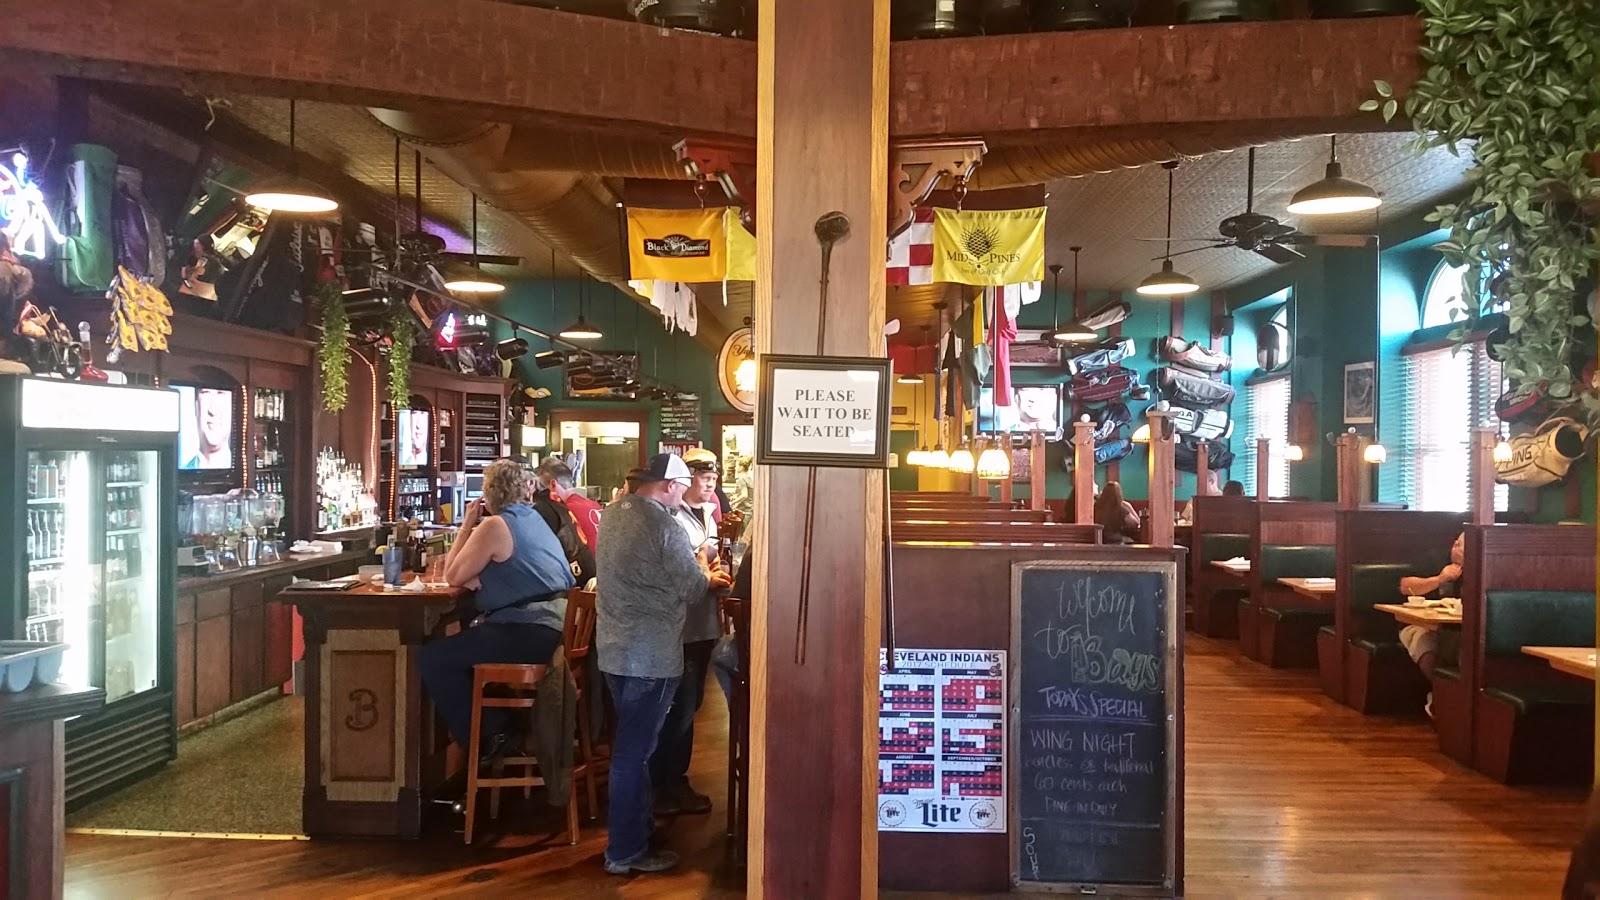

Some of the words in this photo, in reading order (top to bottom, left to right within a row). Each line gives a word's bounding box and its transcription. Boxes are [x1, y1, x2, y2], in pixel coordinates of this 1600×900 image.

[646, 241, 669, 252] Black
[681, 242, 709, 252] Diamond
[946, 250, 969, 263] MID
[989, 253, 1021, 264] PINES
[795, 389, 856, 402] PLEASE
[777, 406, 822, 419] WAIT
[825, 407, 847, 420] TO
[852, 408, 872, 420] BE
[1506, 445, 1533, 468] ING
[950, 653, 1000, 663] INDIANS
[1088, 691, 1148, 718] SPECIAL
[1030, 728, 1073, 750] WING
[1083, 731, 1136, 758] NIGHT
[919, 802, 962, 827] Lite
